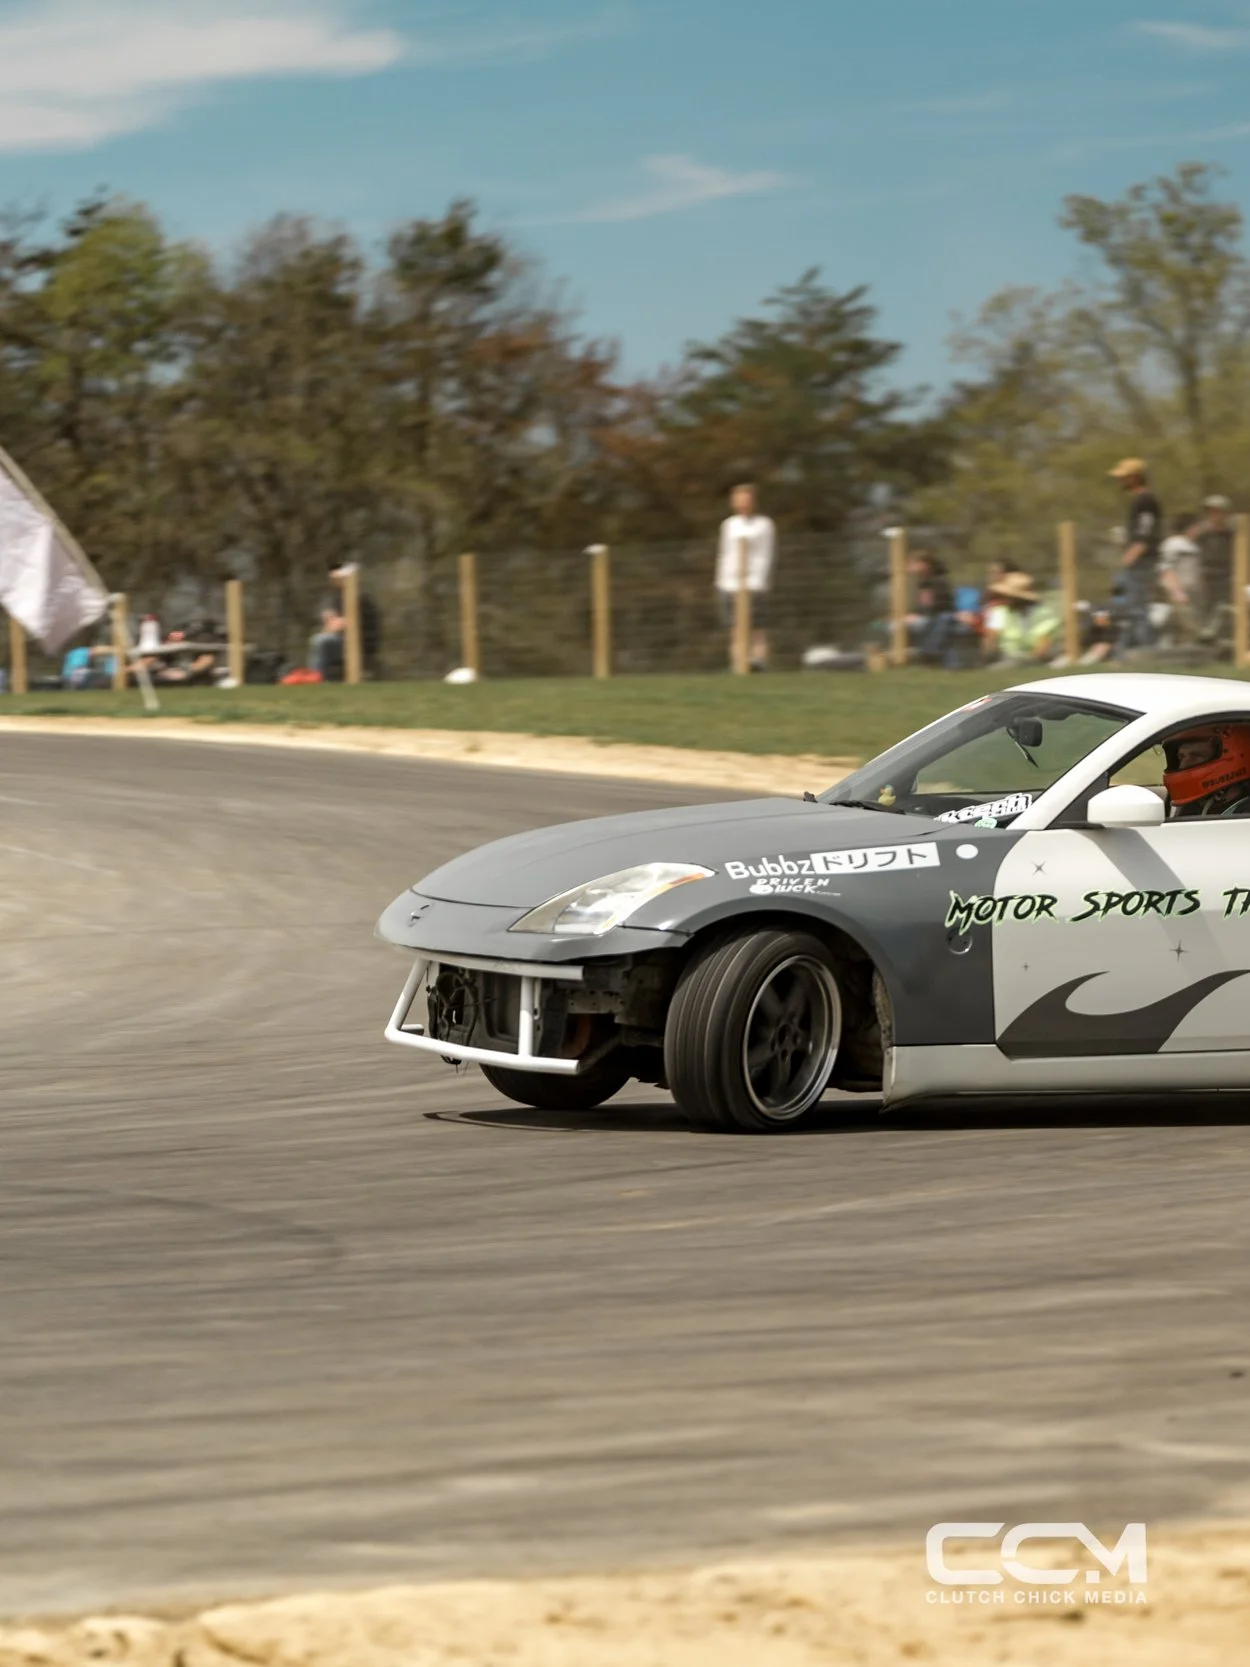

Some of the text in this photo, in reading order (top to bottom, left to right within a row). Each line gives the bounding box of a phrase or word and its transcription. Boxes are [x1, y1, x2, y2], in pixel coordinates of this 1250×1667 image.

[725, 854, 816, 880] Bubbz
[822, 847, 928, 872] ドリフト
[756, 877, 830, 887] DRIVEN
[945, 891, 1059, 935] MOTOR
[1067, 889, 1201, 922] SPORTS
